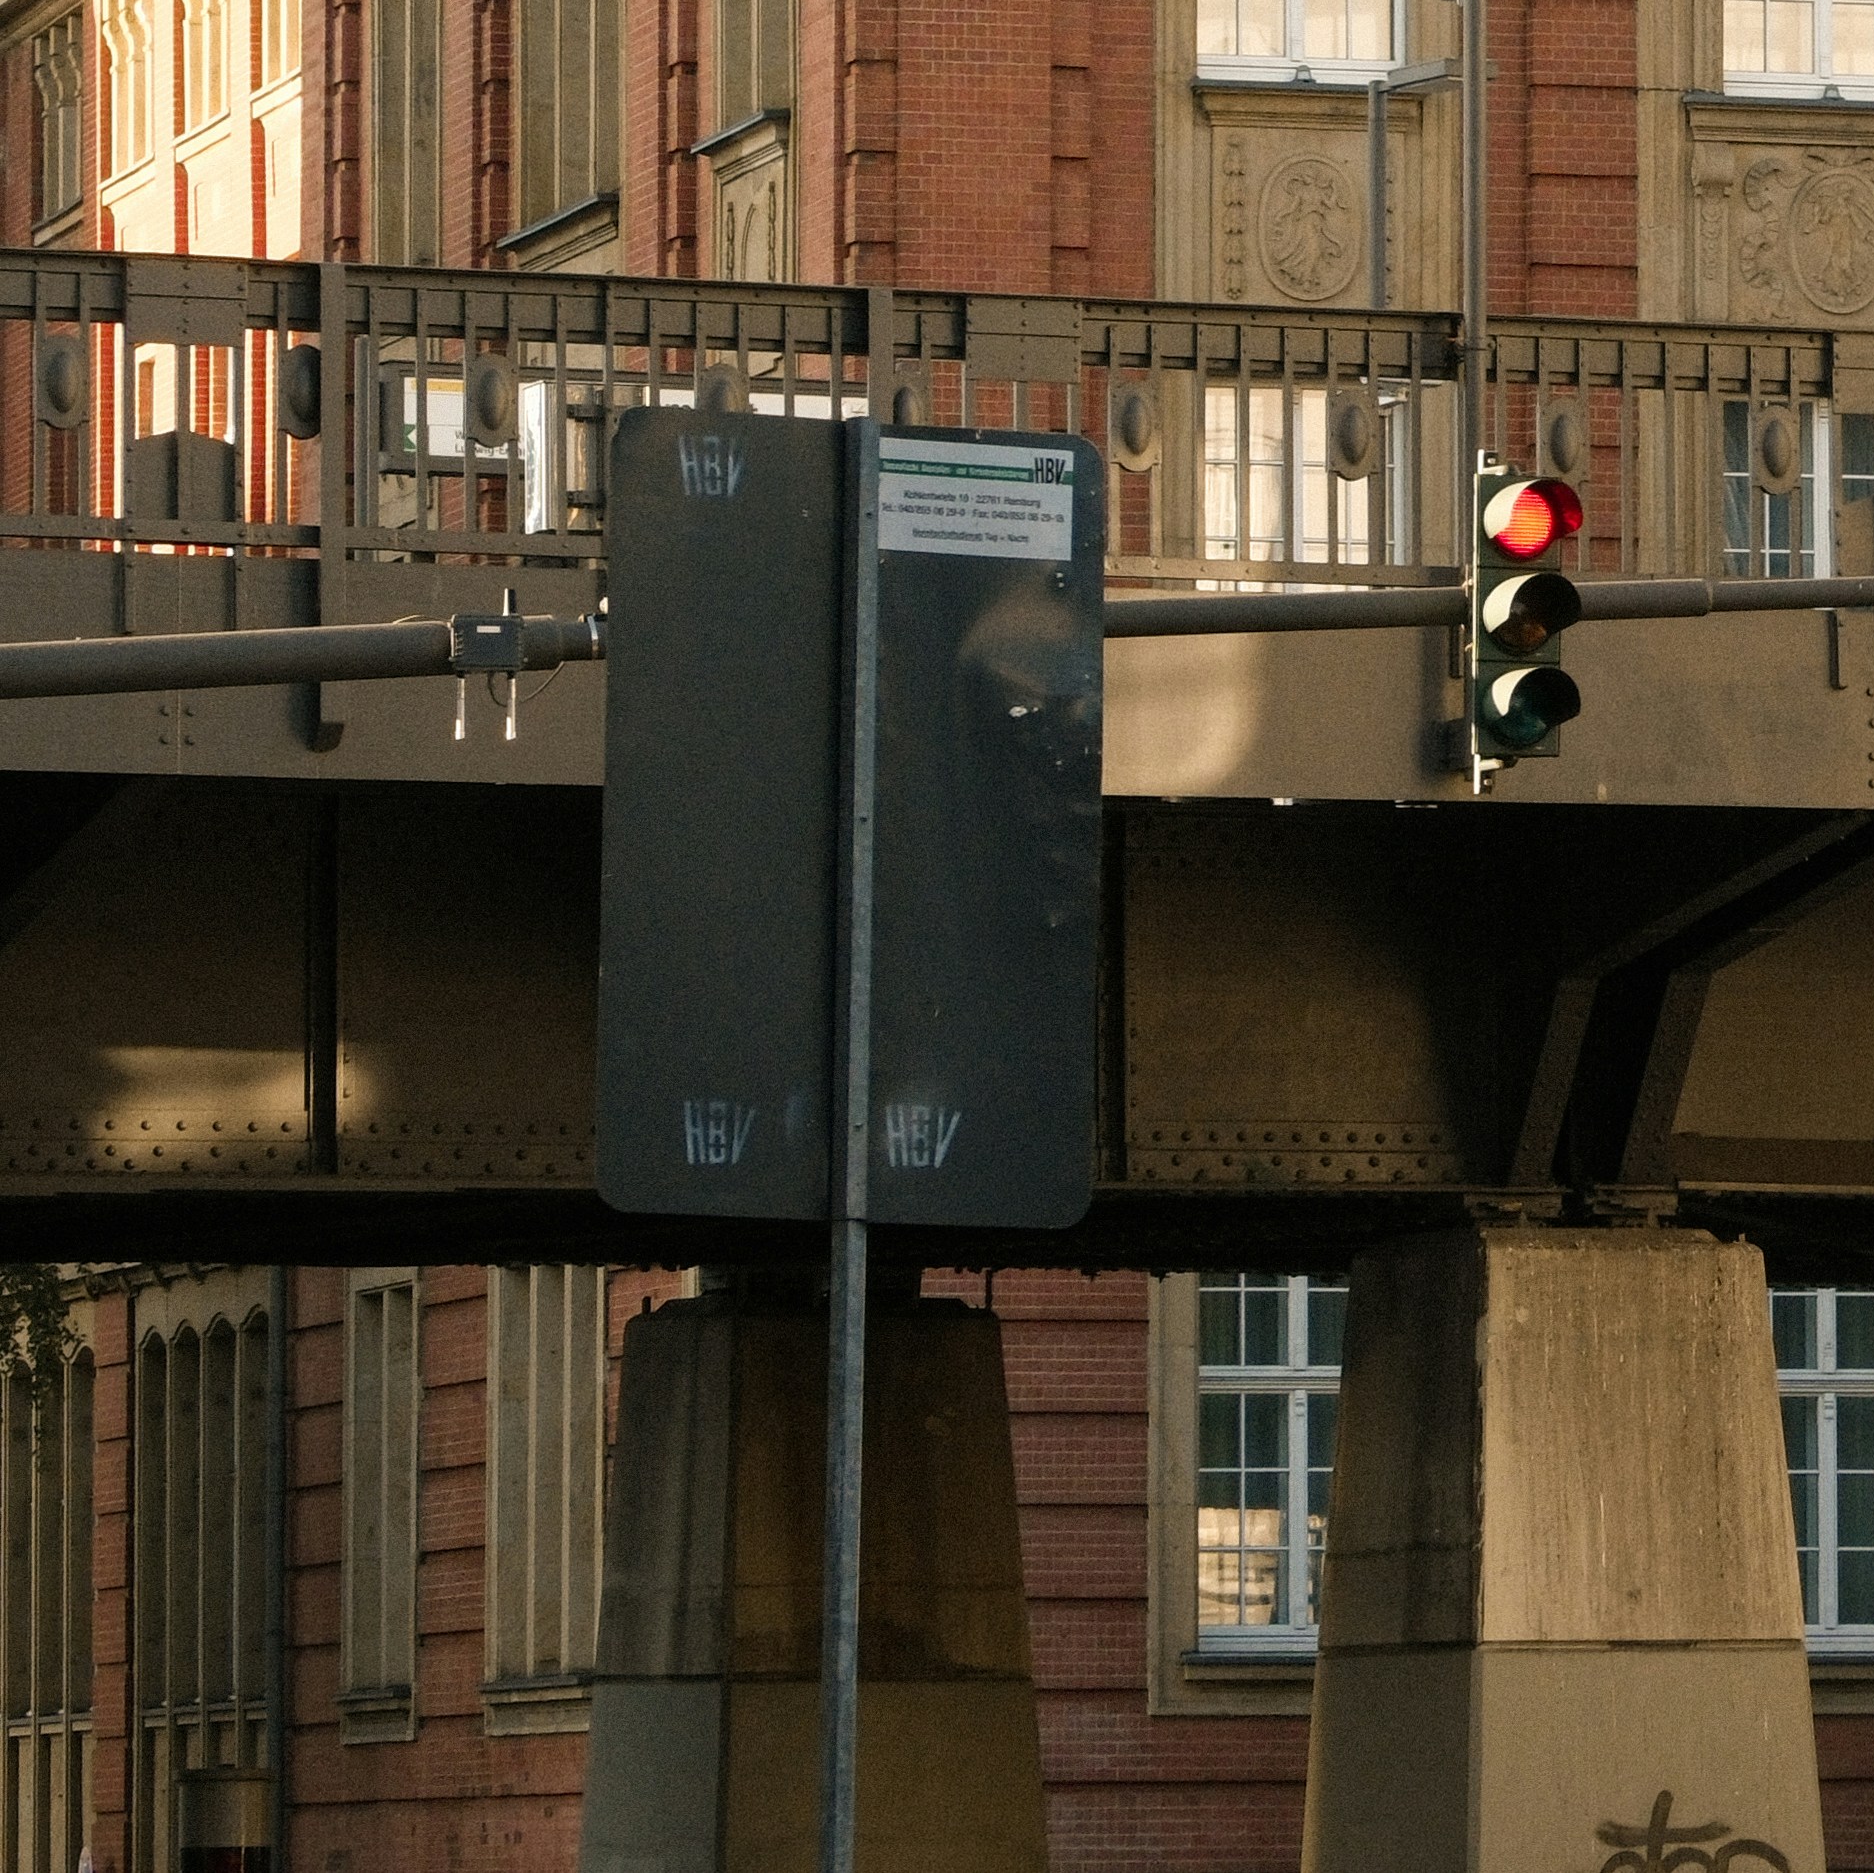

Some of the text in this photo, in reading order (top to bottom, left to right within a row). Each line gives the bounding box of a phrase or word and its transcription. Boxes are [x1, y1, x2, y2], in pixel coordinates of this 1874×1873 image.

[679, 435, 744, 496] HBV
[1034, 457, 1066, 485] HBV
[684, 1100, 756, 1166] HBV
[885, 1104, 962, 1169] HBV
